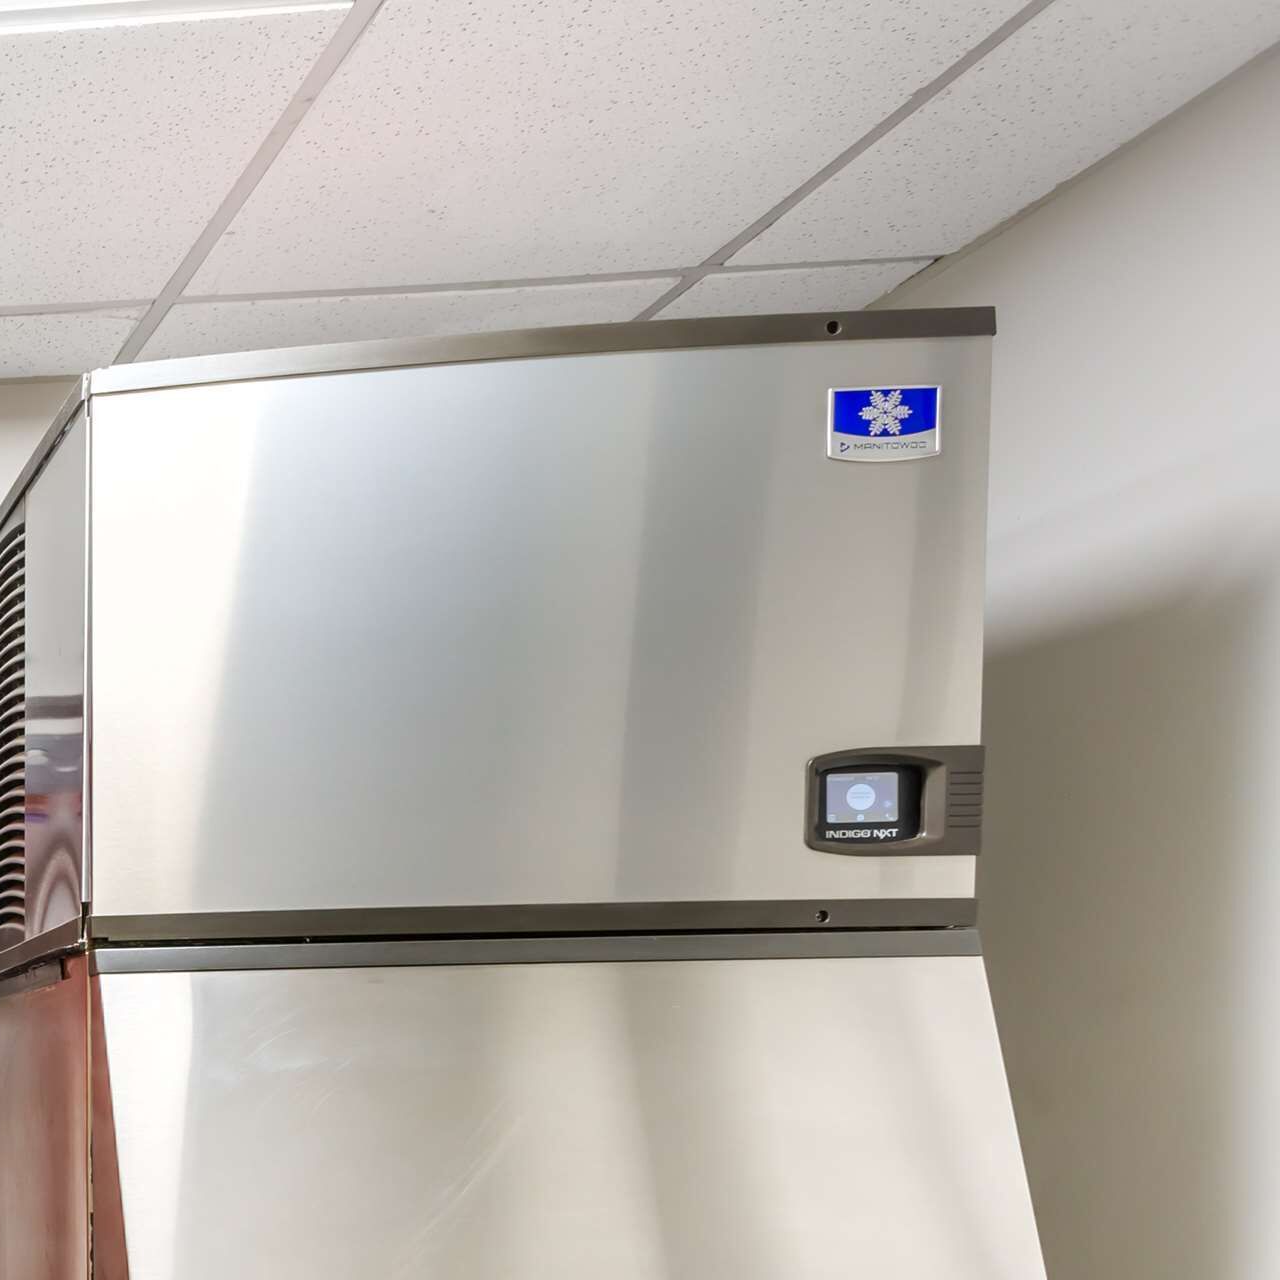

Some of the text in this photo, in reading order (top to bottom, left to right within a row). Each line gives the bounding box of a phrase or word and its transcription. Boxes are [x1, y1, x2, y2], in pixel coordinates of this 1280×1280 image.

[854, 441, 927, 450] MANITOWOC
[826, 829, 898, 839] INDIGO NXT
